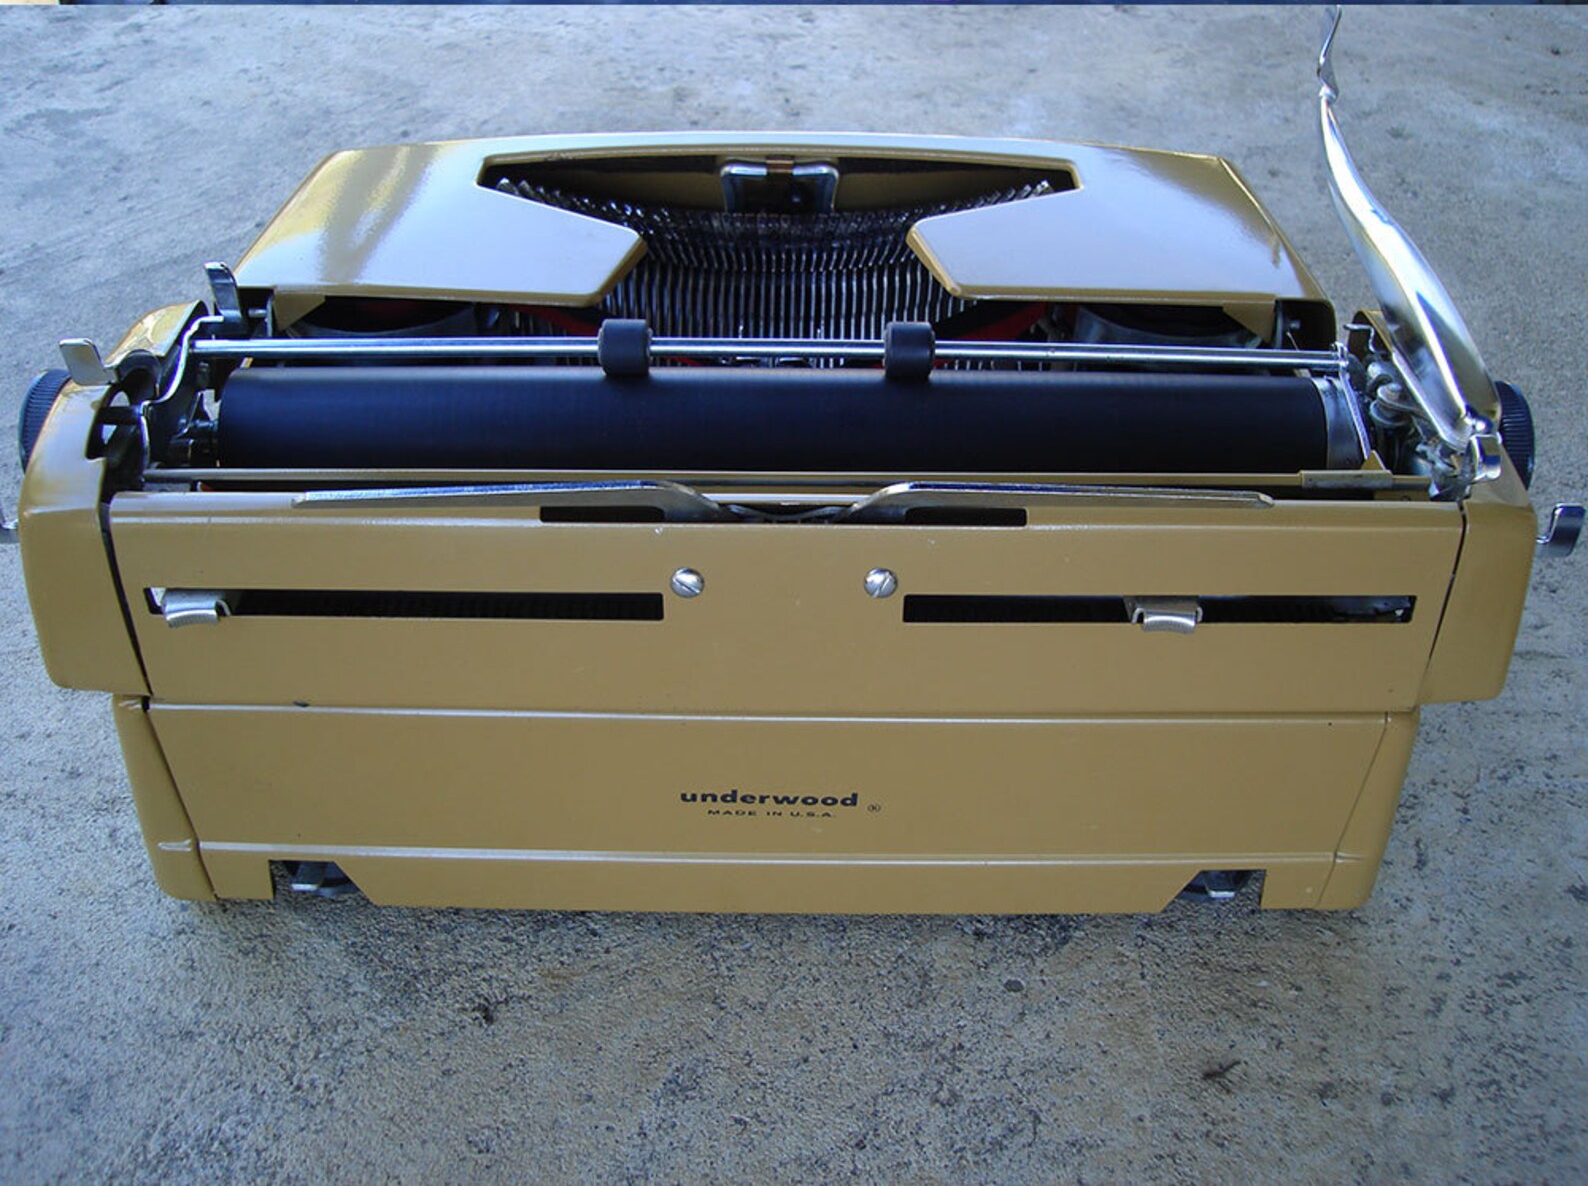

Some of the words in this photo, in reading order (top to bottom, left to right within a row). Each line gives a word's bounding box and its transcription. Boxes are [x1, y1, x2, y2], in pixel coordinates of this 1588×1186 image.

[680, 789, 859, 807] underwood
[707, 809, 757, 817] MADE
[766, 810, 783, 818] IN
